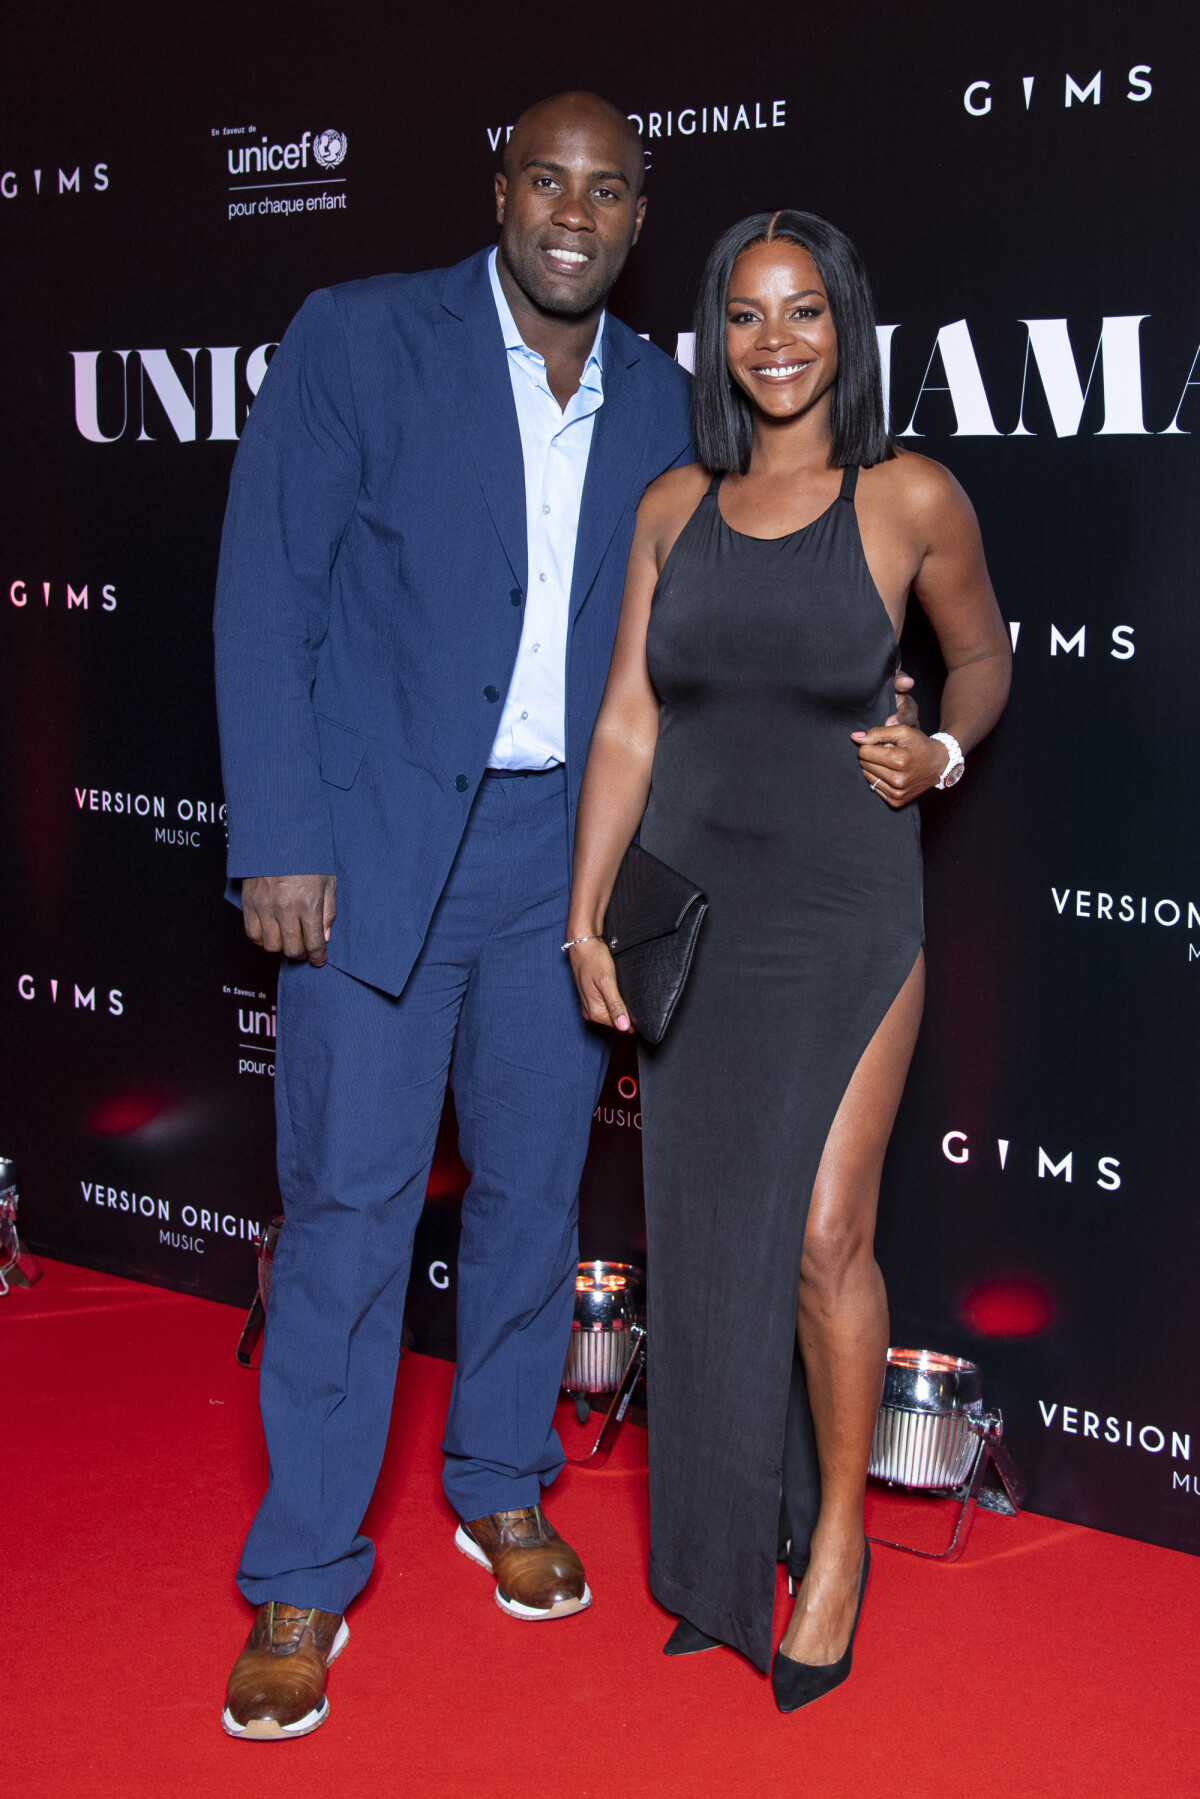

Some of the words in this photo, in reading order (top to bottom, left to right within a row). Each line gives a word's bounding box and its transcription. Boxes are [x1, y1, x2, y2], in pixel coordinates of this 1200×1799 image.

[964, 64, 1152, 117] GIMS
[211, 128, 220, 137] En
[222, 126, 246, 136] faveur
[248, 124, 257, 133] de
[227, 130, 312, 175] unicef
[0, 163, 109, 199] GIMS
[228, 201, 257, 220] pour
[258, 196, 305, 217] chaque
[306, 191, 347, 212] enfant
[10, 580, 117, 611] GIMS
[74, 787, 165, 818] VERSION
[155, 827, 201, 848] MUSIC
[18, 974, 124, 1015] GIMS
[238, 1059, 267, 1075] pour
[942, 1131, 1122, 1190] GIMS
[80, 1180, 170, 1222] VERSION
[158, 1229, 205, 1254] MUSIC
[1038, 1400, 1191, 1461] VERSION
